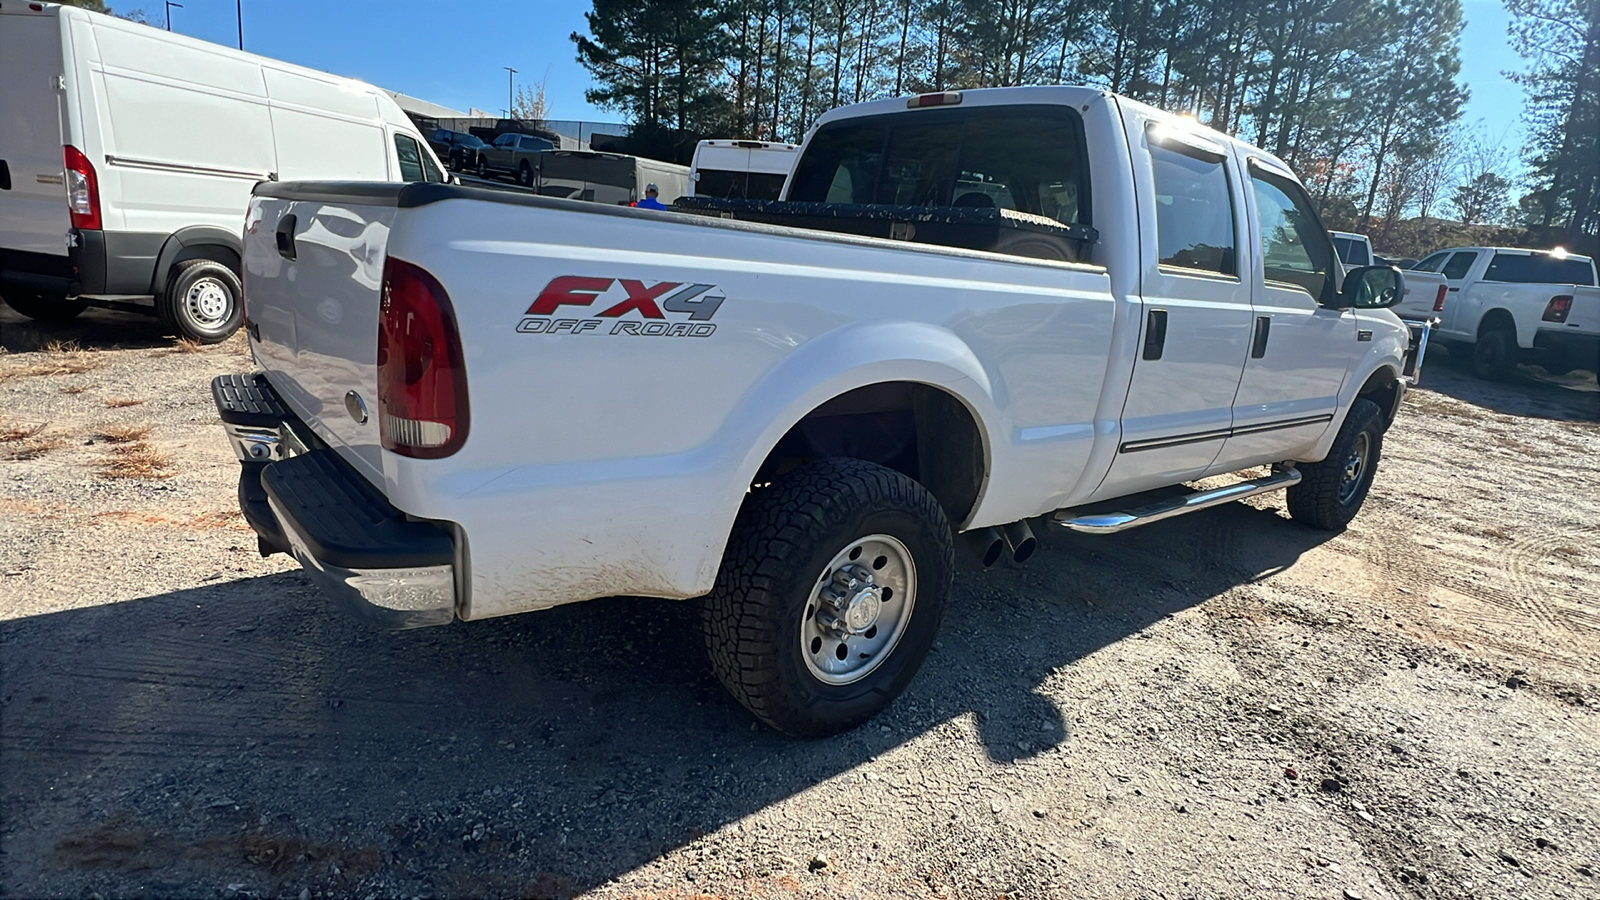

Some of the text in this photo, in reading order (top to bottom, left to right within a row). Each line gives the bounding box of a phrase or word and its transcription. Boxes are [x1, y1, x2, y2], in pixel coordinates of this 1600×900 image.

[524, 275, 727, 321] FX4
[515, 317, 718, 338] OFF ROAD
